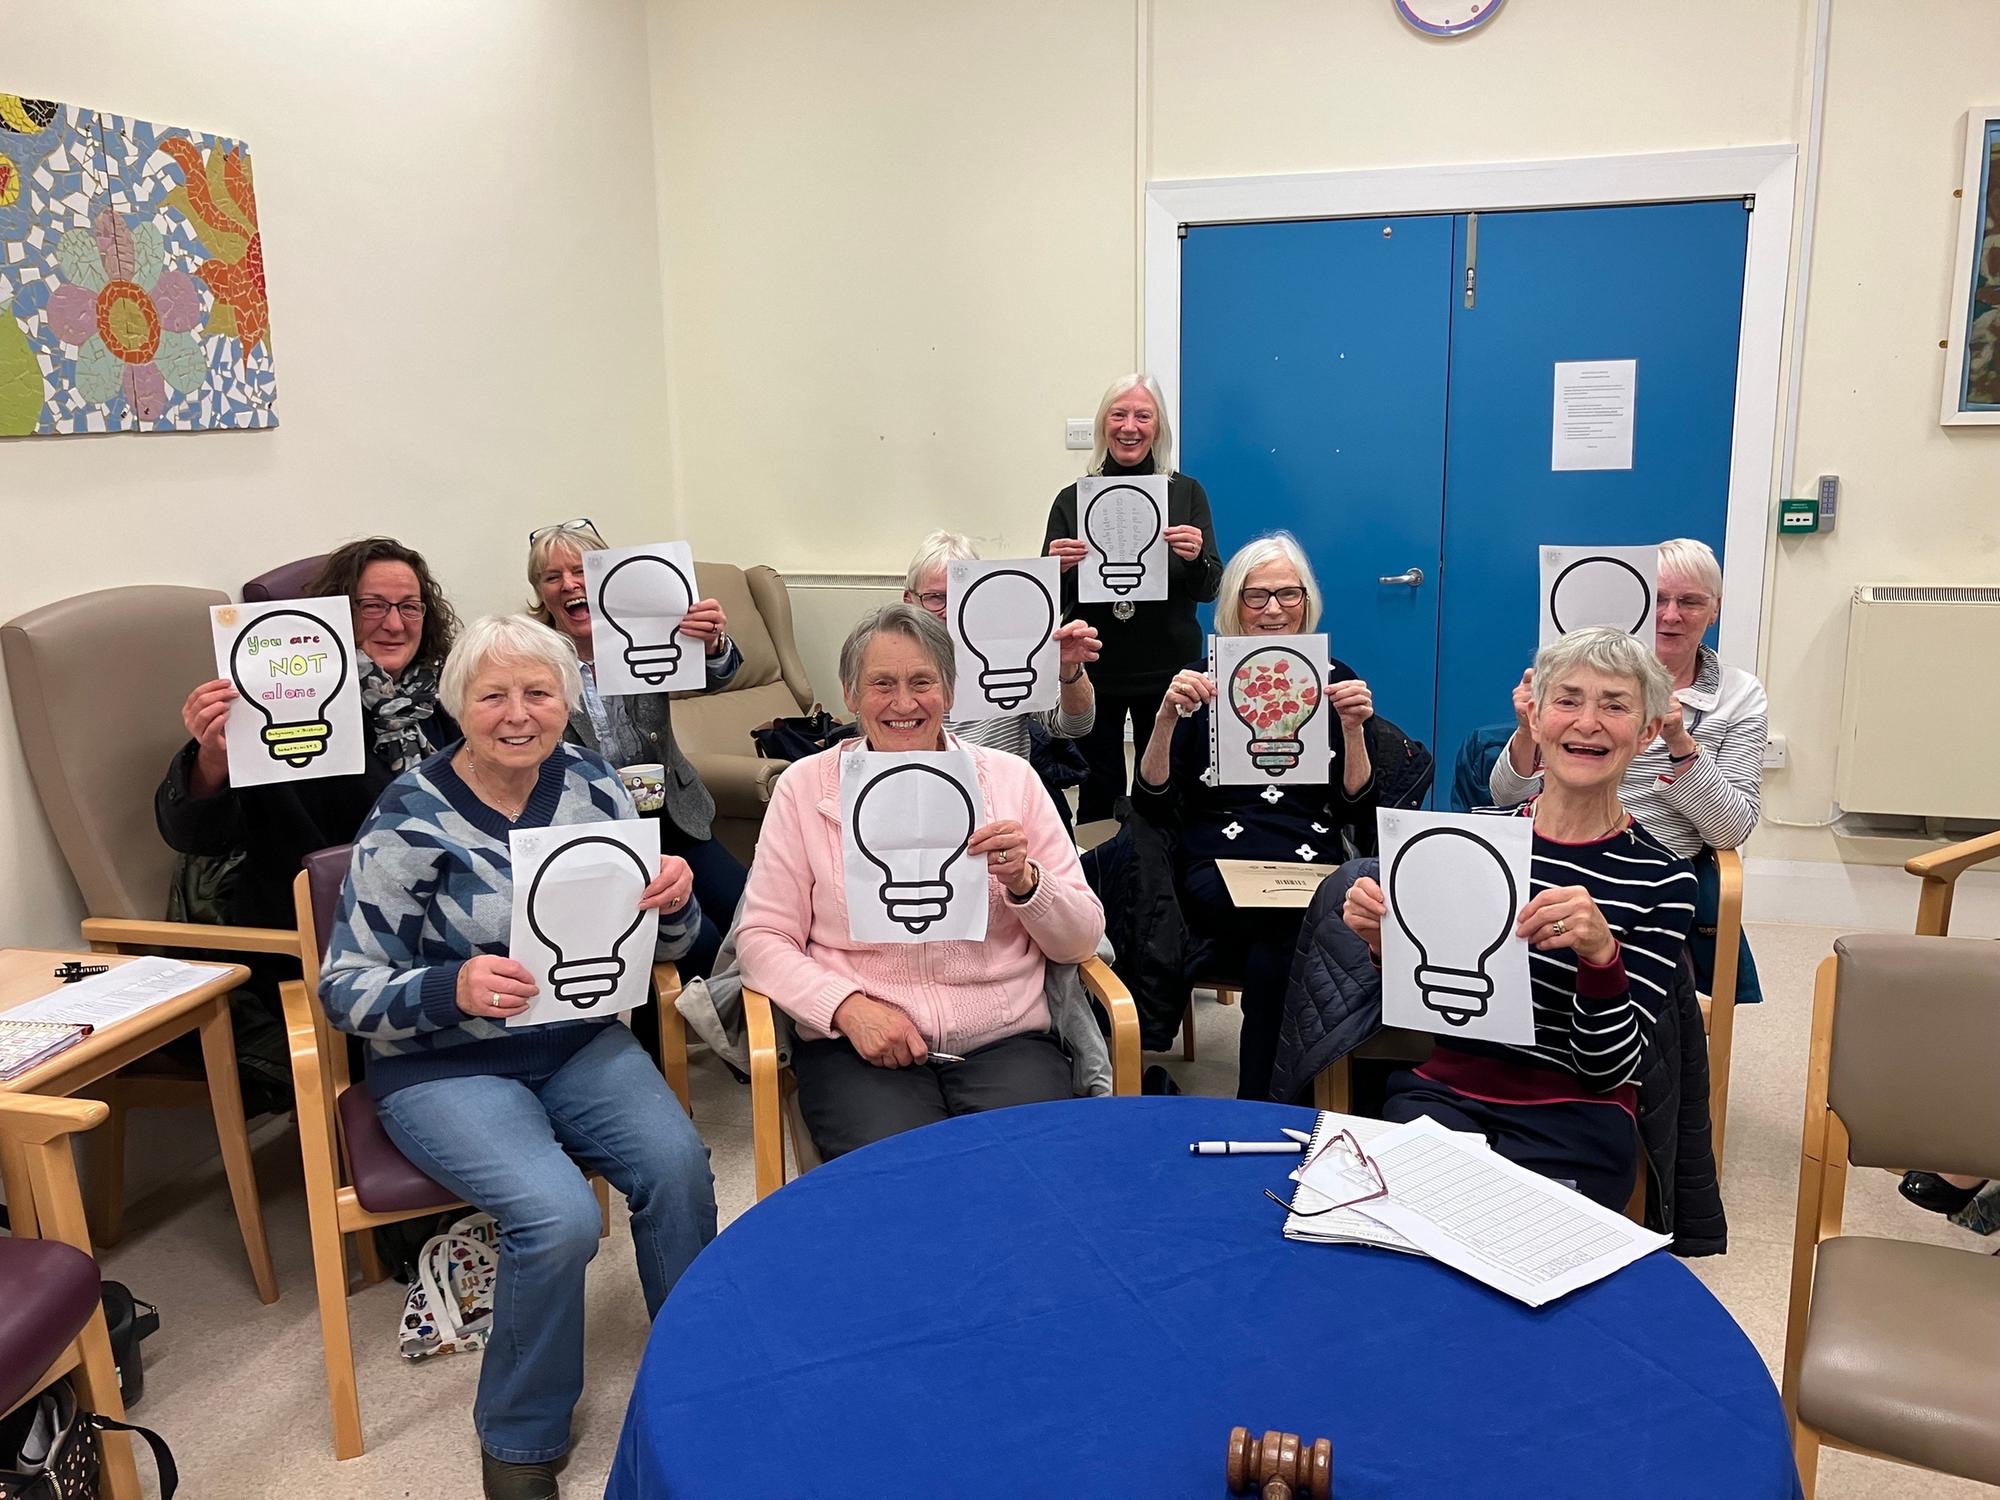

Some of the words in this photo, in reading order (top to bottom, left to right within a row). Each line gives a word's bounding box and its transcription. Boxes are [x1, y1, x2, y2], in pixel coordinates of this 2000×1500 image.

[289, 635, 320, 645] are
[269, 653, 328, 678] NOT
[262, 682, 316, 700] alone
